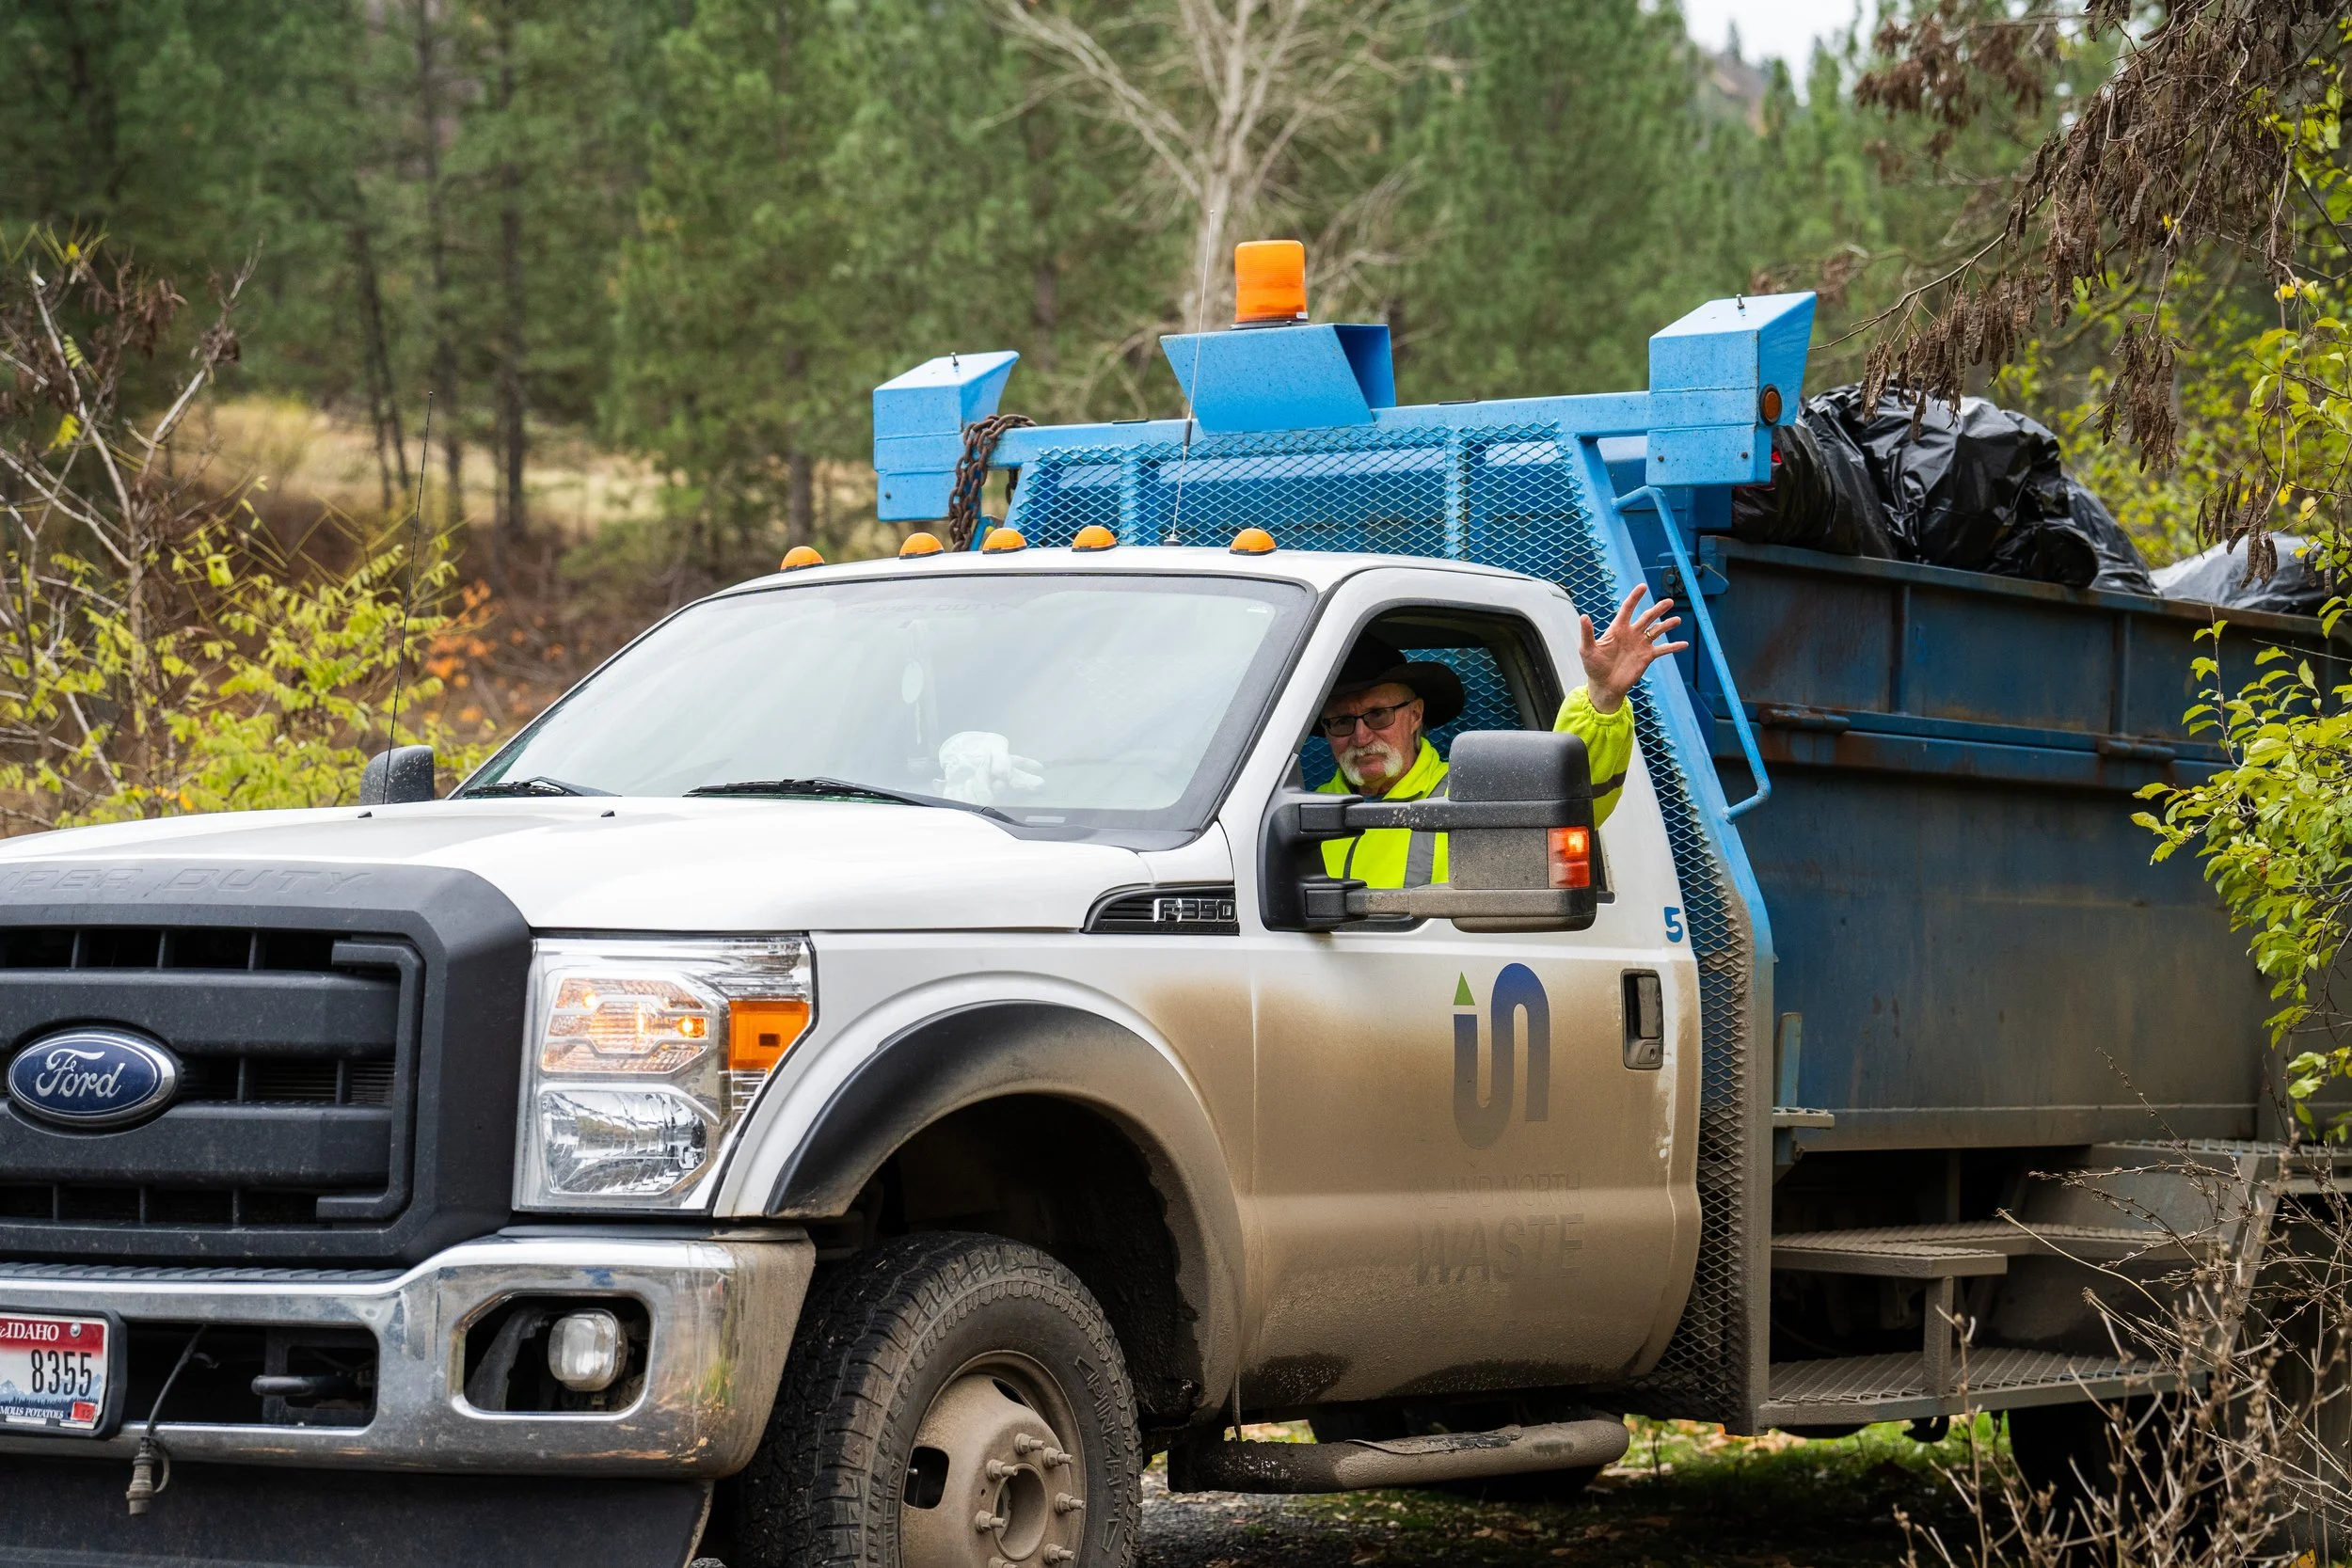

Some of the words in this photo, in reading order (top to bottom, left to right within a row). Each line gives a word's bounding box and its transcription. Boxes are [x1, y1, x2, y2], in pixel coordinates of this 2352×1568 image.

[162, 868, 373, 894] DUTY
[1663, 906, 1684, 943] 5
[35, 1048, 125, 1099] Ford
[1502, 1171, 1584, 1207] NORTH
[1413, 1213, 1584, 1286] WASTE
[7, 1322, 59, 1341] IDAHO
[31, 1349, 92, 1397] 8355
[25, 1407, 64, 1419] POTATOES
